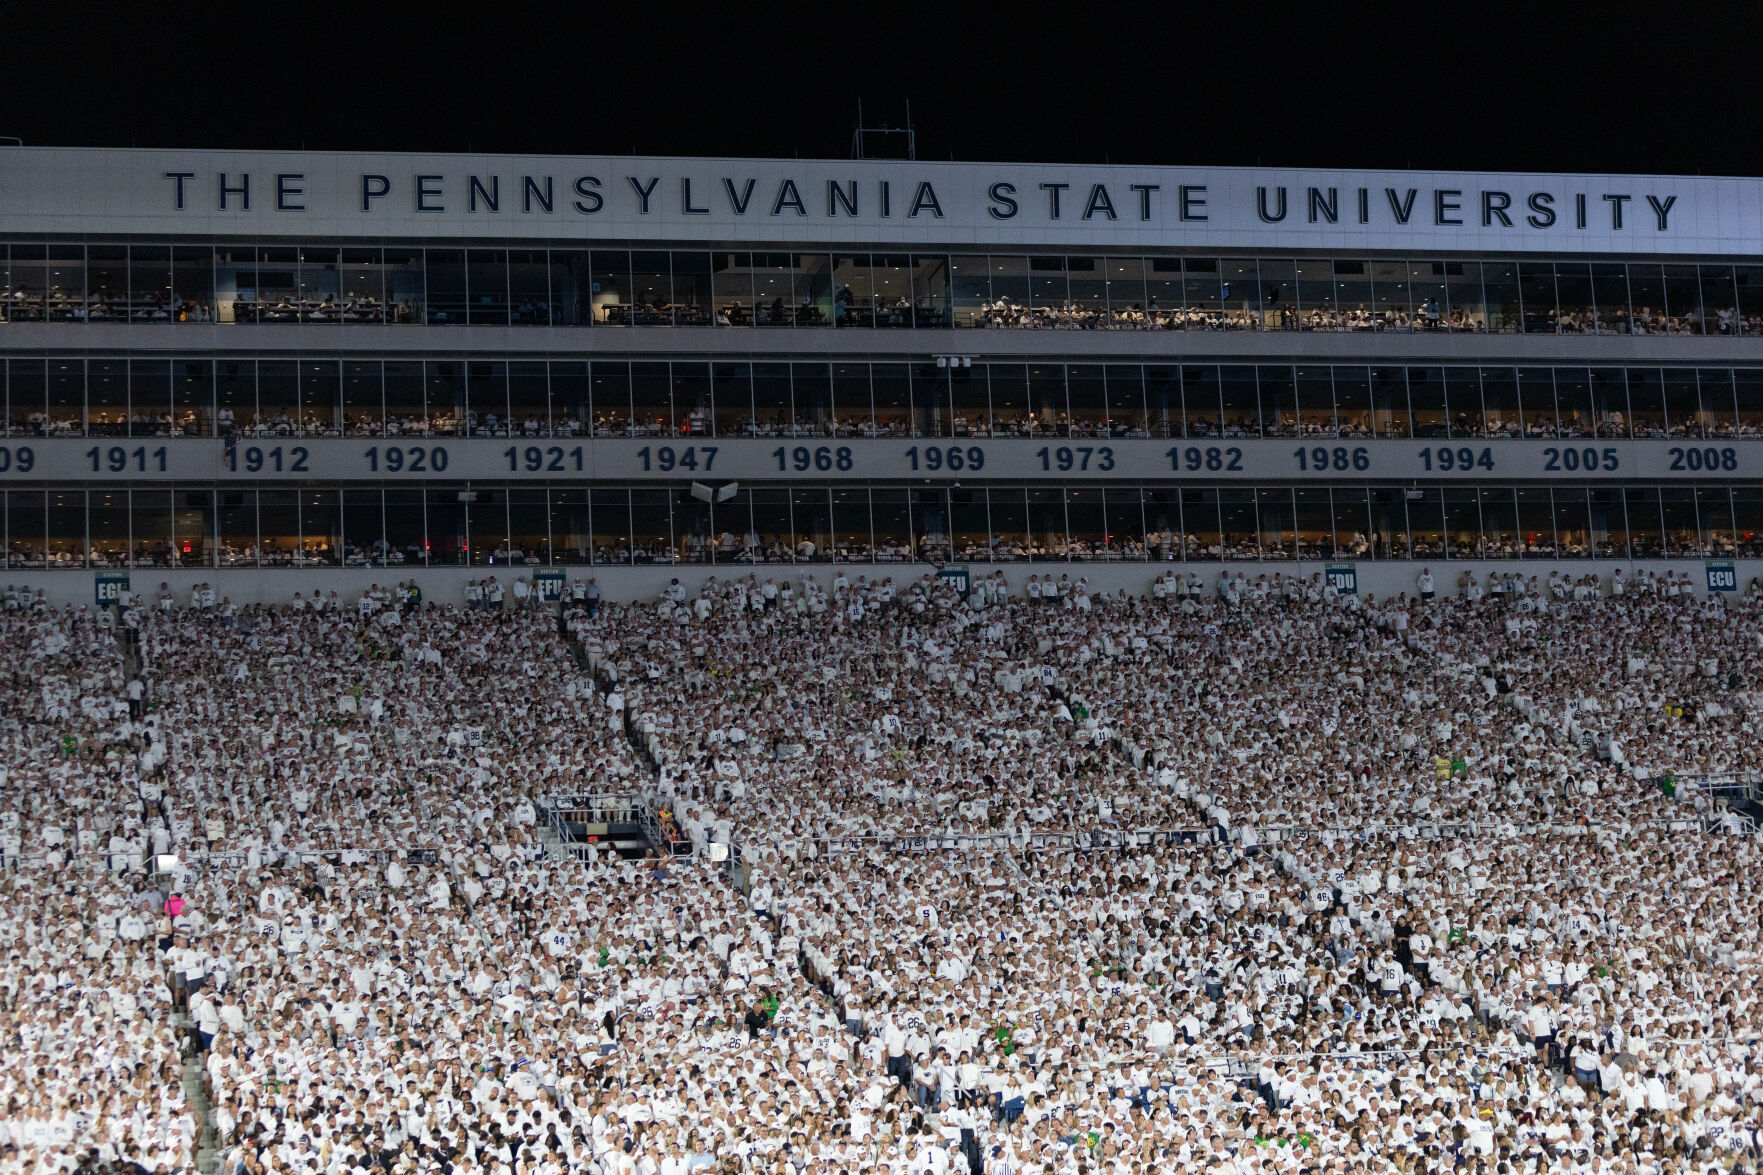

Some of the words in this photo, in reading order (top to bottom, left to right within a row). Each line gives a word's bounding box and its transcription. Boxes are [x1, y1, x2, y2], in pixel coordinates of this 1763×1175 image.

[164, 172, 305, 212] THE
[361, 173, 944, 219] PENNSYLVANIA
[988, 181, 1209, 222] STATE
[1257, 186, 1678, 231] UNIVERSITY
[86, 447, 167, 472] 1911
[228, 447, 309, 472] 1912
[365, 447, 449, 472] 1920
[505, 447, 583, 472] 1921
[638, 447, 719, 472] 1947
[773, 447, 853, 472] 1968
[906, 447, 985, 472] 1969
[1037, 447, 1115, 471] 1973
[1166, 447, 1243, 471] 1982
[1294, 447, 1370, 471] 1986
[1420, 448, 1495, 471] 1994
[1544, 448, 1619, 471] 2005
[1669, 448, 1738, 471] 2008
[1709, 571, 1734, 587] ECU
[98, 583, 122, 599] EG
[889, 718, 896, 726] 10
[1099, 732, 1106, 740] 11
[1572, 920, 1581, 929] 14
[553, 935, 565, 946] 44
[1279, 973, 1286, 984] 11
[1385, 968, 1395, 980] 16
[907, 1017, 919, 1029] 26
[729, 1037, 741, 1049] 26
[927, 1151, 934, 1164] 1
